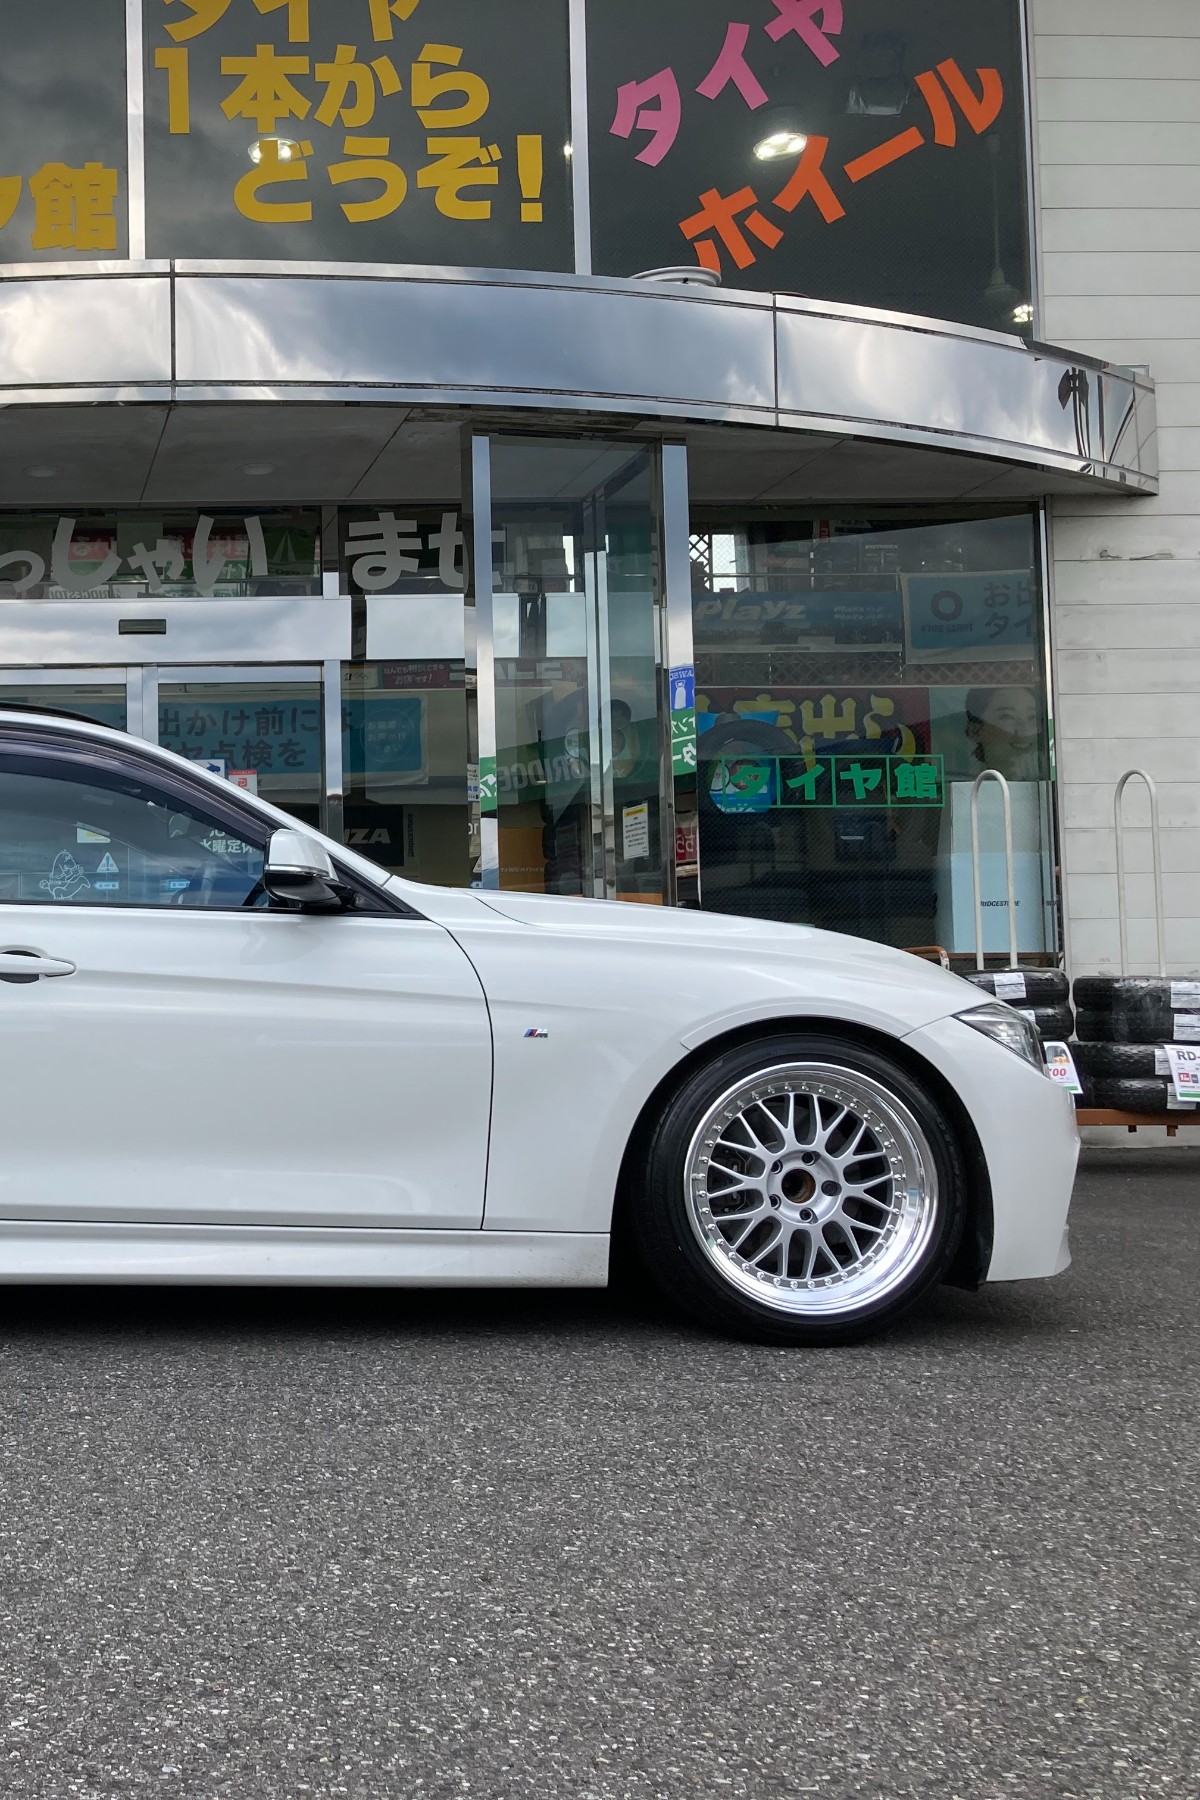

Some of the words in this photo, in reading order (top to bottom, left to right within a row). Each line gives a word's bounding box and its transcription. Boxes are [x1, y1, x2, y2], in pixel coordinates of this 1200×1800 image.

[155, 44, 490, 134] 1本から
[610, 0, 844, 167] タイヤ
[233, 135, 544, 224] どうぞ!
[678, 57, 1004, 274] ホイール
[120, 706, 354, 737] 出かけ前に
[730, 762, 937, 801] タイヤ館
